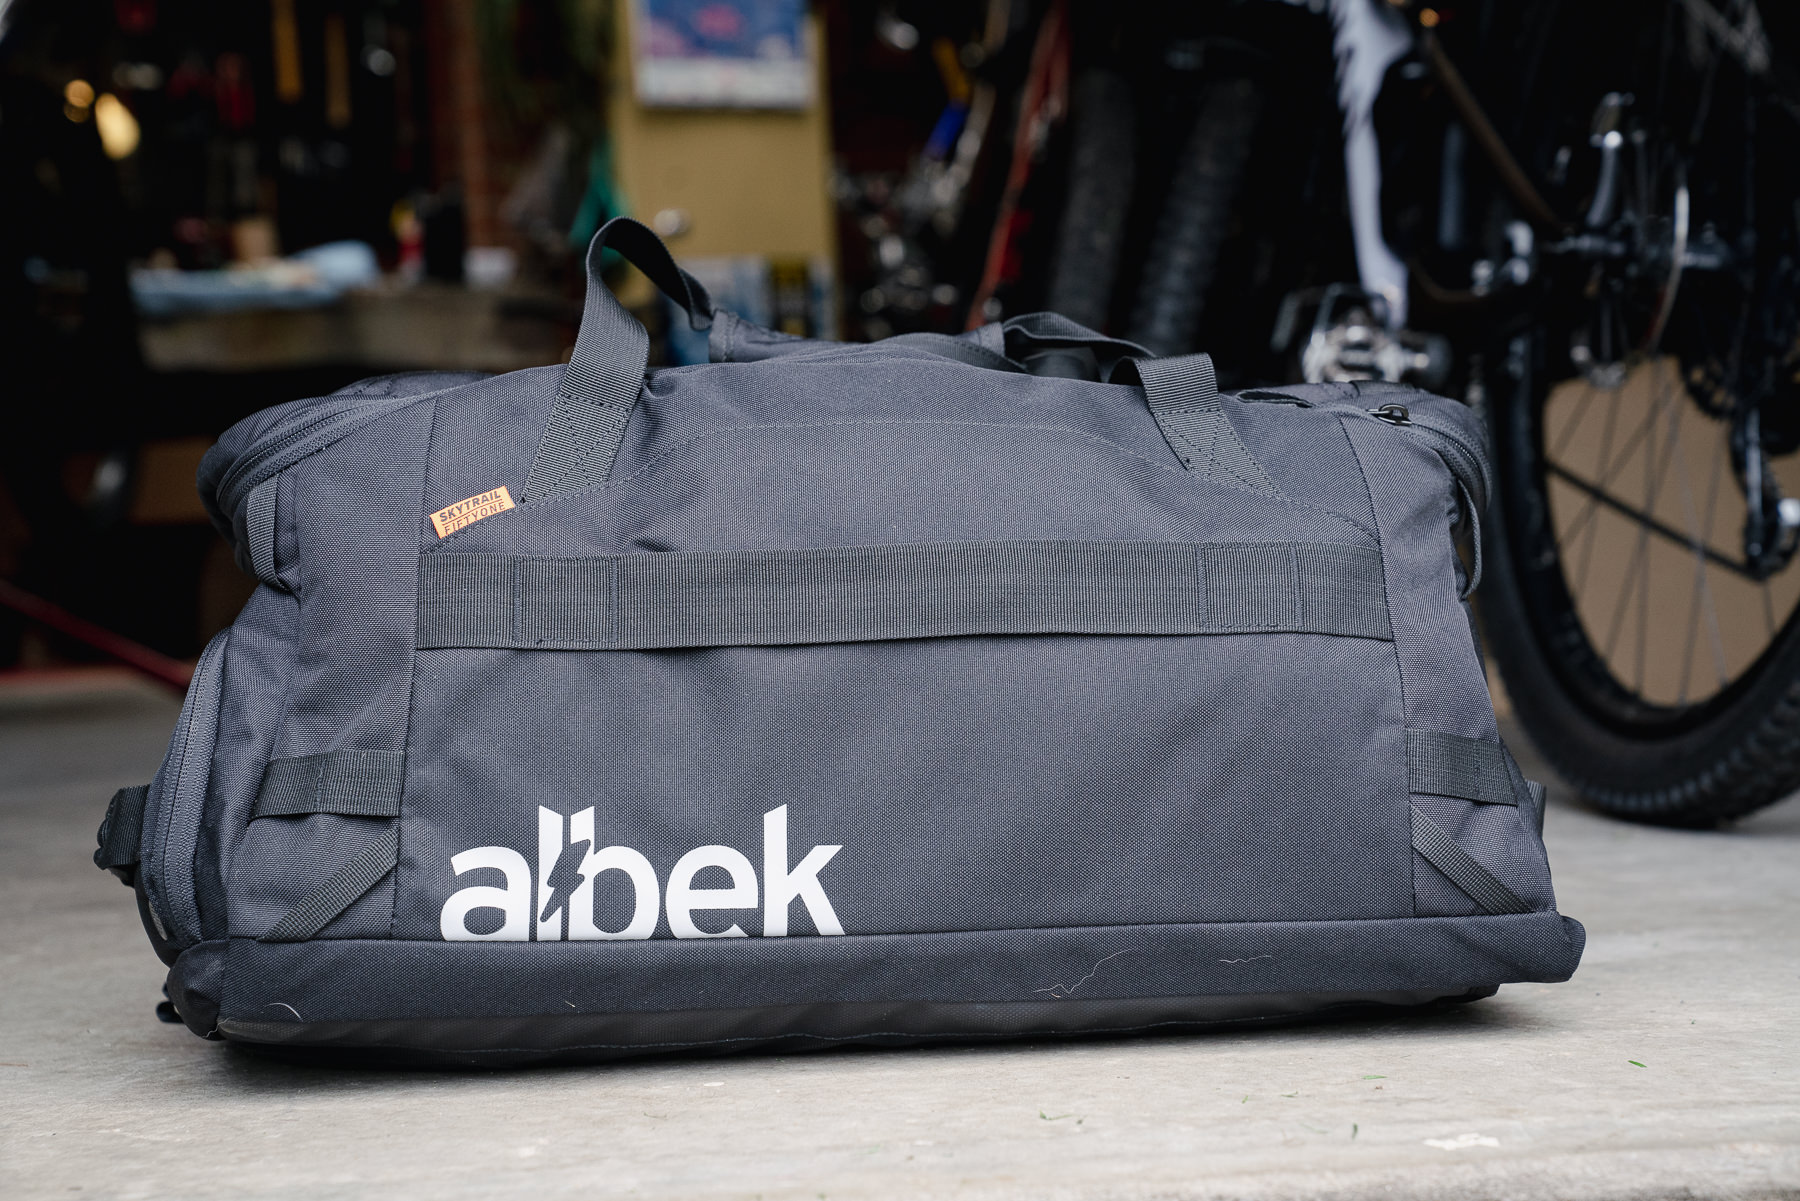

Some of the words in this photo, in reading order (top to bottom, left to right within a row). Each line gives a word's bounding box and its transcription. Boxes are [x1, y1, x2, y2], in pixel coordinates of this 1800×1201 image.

[439, 490, 501, 522] SKYTRAIL
[444, 501, 505, 535] FIFTYONE
[440, 804, 846, 942] albek
